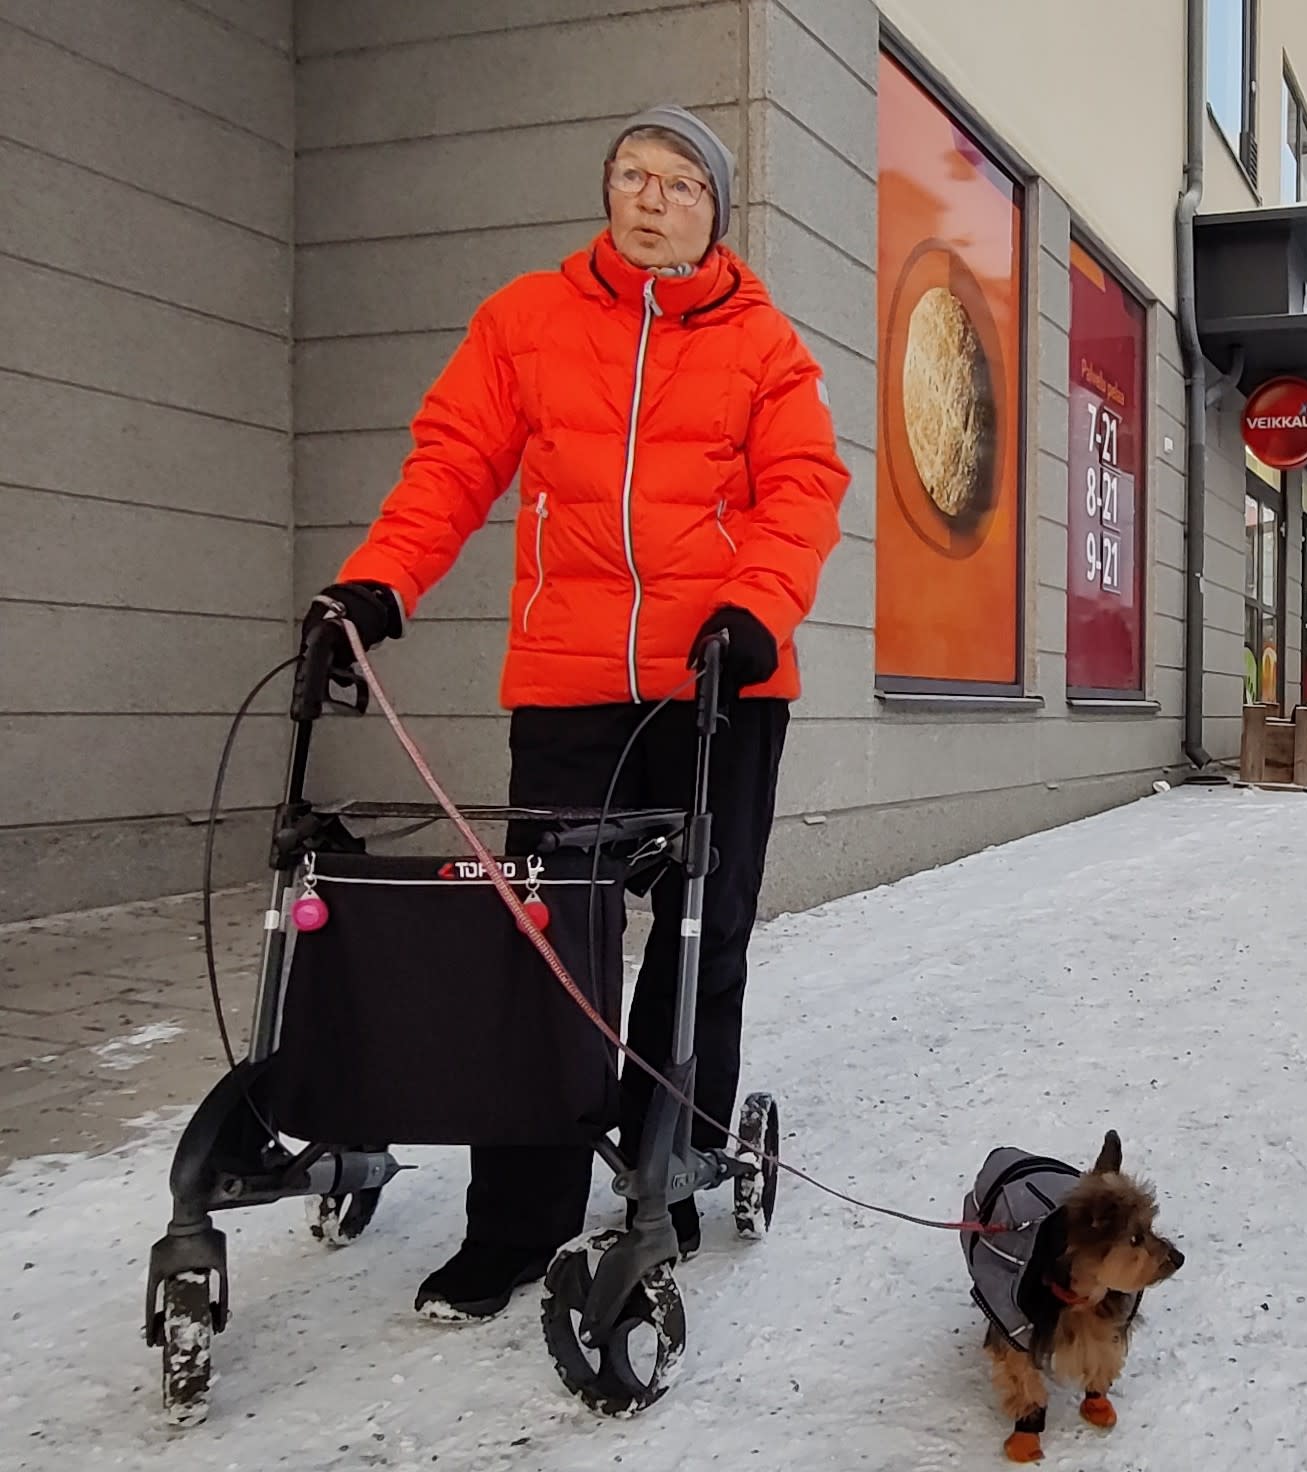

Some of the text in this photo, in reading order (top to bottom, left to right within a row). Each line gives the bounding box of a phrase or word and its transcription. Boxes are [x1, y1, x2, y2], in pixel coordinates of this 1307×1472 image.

[1087, 403, 1118, 465] 7-21
[1086, 467, 1118, 523] 8-21
[1086, 532, 1118, 587] 9-21
[455, 861, 516, 878] TOPO
